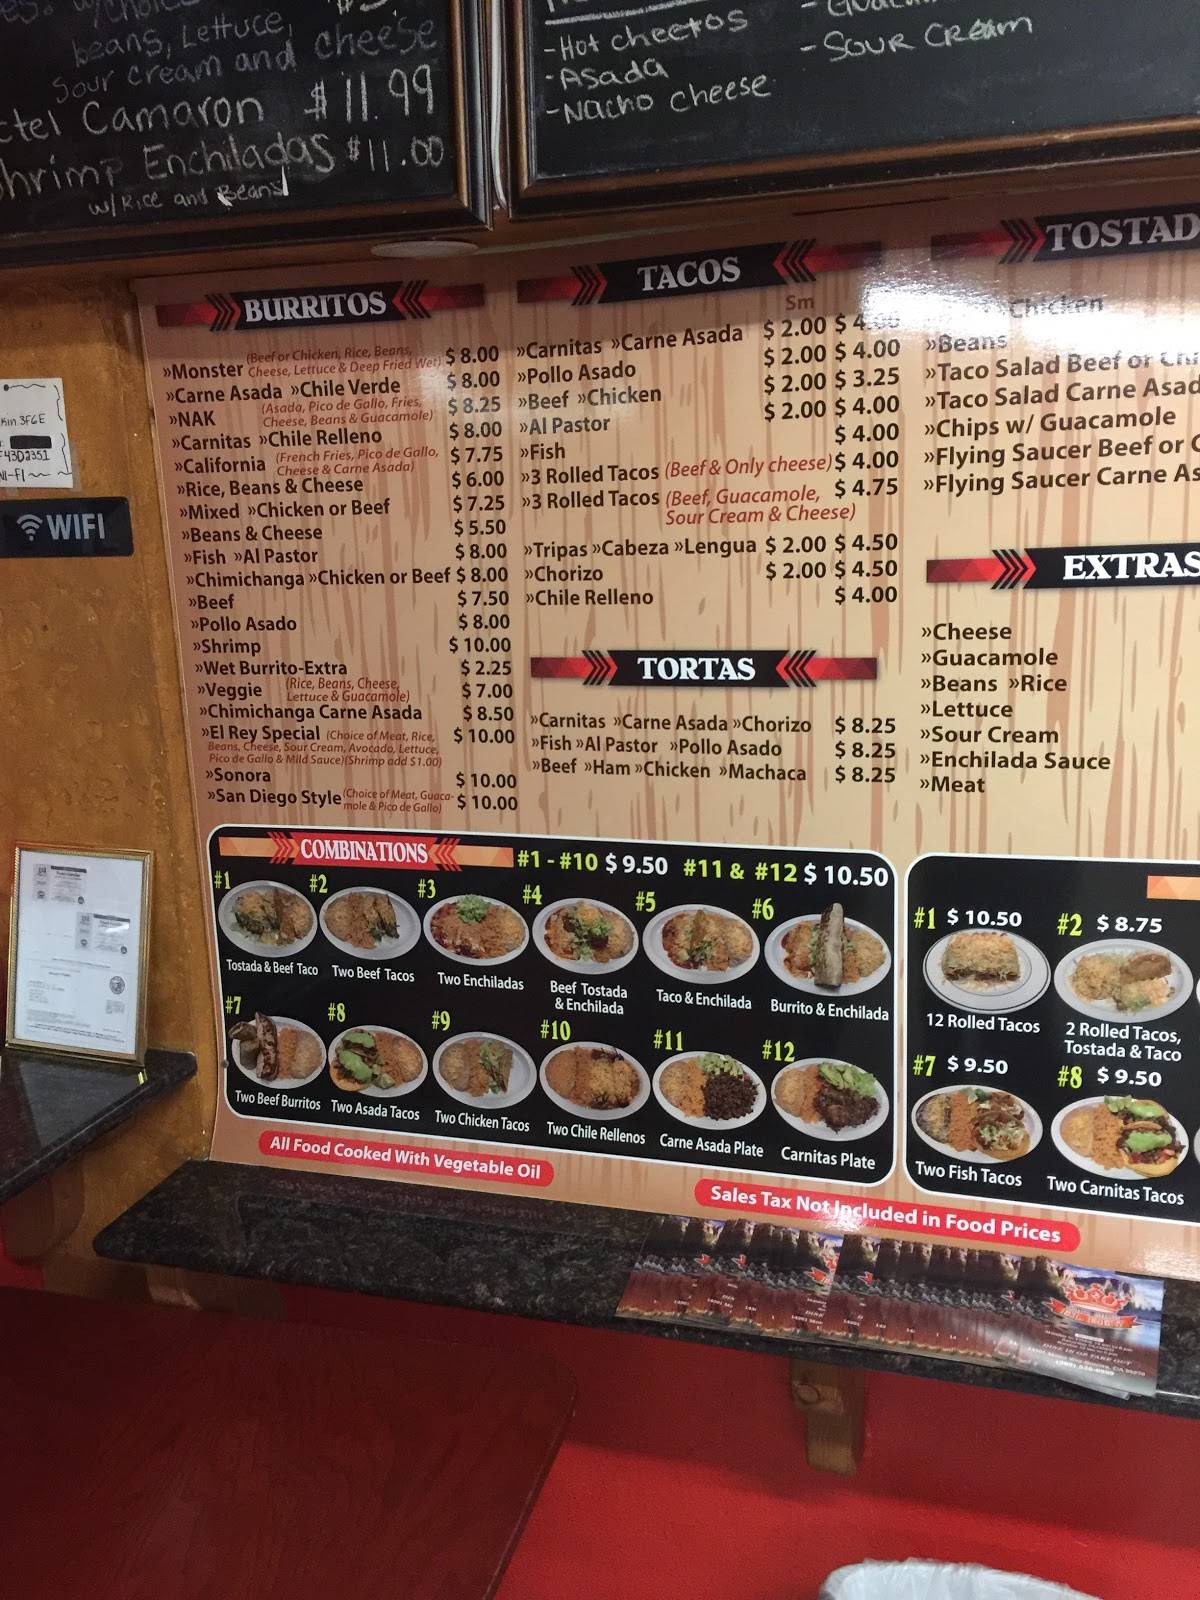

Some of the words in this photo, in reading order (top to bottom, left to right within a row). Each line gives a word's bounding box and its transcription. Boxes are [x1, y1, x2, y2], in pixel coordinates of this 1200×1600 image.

[235, 40, 296, 72] and
[83, 97, 264, 134] Camaron
[637, 256, 741, 292] TACOS
[244, 291, 388, 322] BURRITOS
[786, 295, 815, 310] Sm
[526, 337, 602, 359] Carnitas
[621, 333, 677, 352] Carne
[682, 324, 743, 346] Asada
[938, 333, 1008, 353] Beans
[171, 364, 243, 380] Monster
[175, 387, 225, 403] Carne
[230, 383, 282, 400] Asada
[300, 381, 346, 398] Chile
[349, 378, 401, 394] Verde
[937, 391, 988, 410] Taco
[994, 384, 1059, 407] Salad
[1066, 382, 1136, 402] Carne
[178, 410, 216, 427] NAK
[937, 417, 1000, 440] Chips
[1040, 406, 1176, 432] Guacamole
[183, 458, 266, 475] California
[531, 469, 542, 485] 3
[546, 466, 604, 484] Rolled
[608, 465, 659, 482] Tacos
[710, 460, 720, 476] &
[725, 458, 764, 479] Only
[768, 454, 833, 473] cheese)
[936, 473, 1004, 497] Flying
[1012, 470, 1091, 490] Saucer
[1097, 466, 1167, 486] Carne
[188, 503, 240, 520] Mixed
[256, 499, 324, 518] Chicken
[328, 502, 348, 517] or
[351, 498, 391, 515] Beef
[47, 513, 105, 540] WIFI
[533, 542, 588, 561] Tripas
[602, 539, 669, 557] Cabeza
[684, 538, 757, 558] Lengua
[1063, 550, 1200, 580] EXTRAS
[201, 638, 261, 656] Shrimp
[932, 648, 1058, 666] Guacamole
[203, 660, 236, 676] Wet
[239, 659, 348, 676] Burrito-Extra
[637, 657, 755, 681] TORTAS
[205, 683, 263, 700] Veggie
[539, 712, 606, 728] Carnitas
[622, 714, 671, 730] Carne
[676, 715, 729, 731] Asada
[742, 715, 812, 733] Chorizo
[210, 726, 226, 741] El
[229, 726, 258, 743] Rey
[262, 726, 320, 742] Special
[541, 759, 578, 775] Beef
[593, 760, 631, 776] Ham
[644, 761, 711, 779] Chicken
[729, 764, 807, 782] Machaca
[931, 751, 1038, 770] Enchilada
[1044, 752, 1111, 770] Sauce
[216, 789, 247, 804] San
[250, 789, 297, 806] Diego
[301, 790, 342, 806] Style
[300, 838, 428, 864] COMBINATIONS
[560, 851, 598, 872] #10
[309, 874, 328, 894] #2
[914, 907, 936, 929] #1
[226, 959, 262, 974] Tostada
[264, 961, 271, 974] &
[273, 962, 294, 975] Beef
[297, 963, 318, 976] Taco
[770, 999, 814, 1016] Burrito
[816, 1002, 825, 1016] &
[829, 1003, 889, 1022] Enchilada
[927, 1012, 944, 1028] 12
[948, 1014, 994, 1031] Rolled
[998, 1017, 1040, 1034] Tacos
[762, 1039, 795, 1062] #12
[235, 1089, 255, 1105] Two
[257, 1092, 280, 1107] Beef
[282, 1094, 321, 1112] Burritos
[659, 1133, 694, 1150] Carne
[696, 1136, 731, 1154] Asada
[734, 1139, 764, 1158] Plate
[270, 1136, 291, 1151] All
[293, 1139, 330, 1155] Food
[333, 1143, 392, 1162] Cooked
[395, 1149, 430, 1166] With
[434, 1153, 513, 1176] Vegetable
[518, 1162, 541, 1180] Oil
[711, 1184, 758, 1205] Sales
[760, 1191, 792, 1210] Tax
[796, 1194, 830, 1213] Not
[922, 1211, 941, 1228] in
[946, 1213, 996, 1236] Food
[1001, 1220, 1061, 1244] Prices
